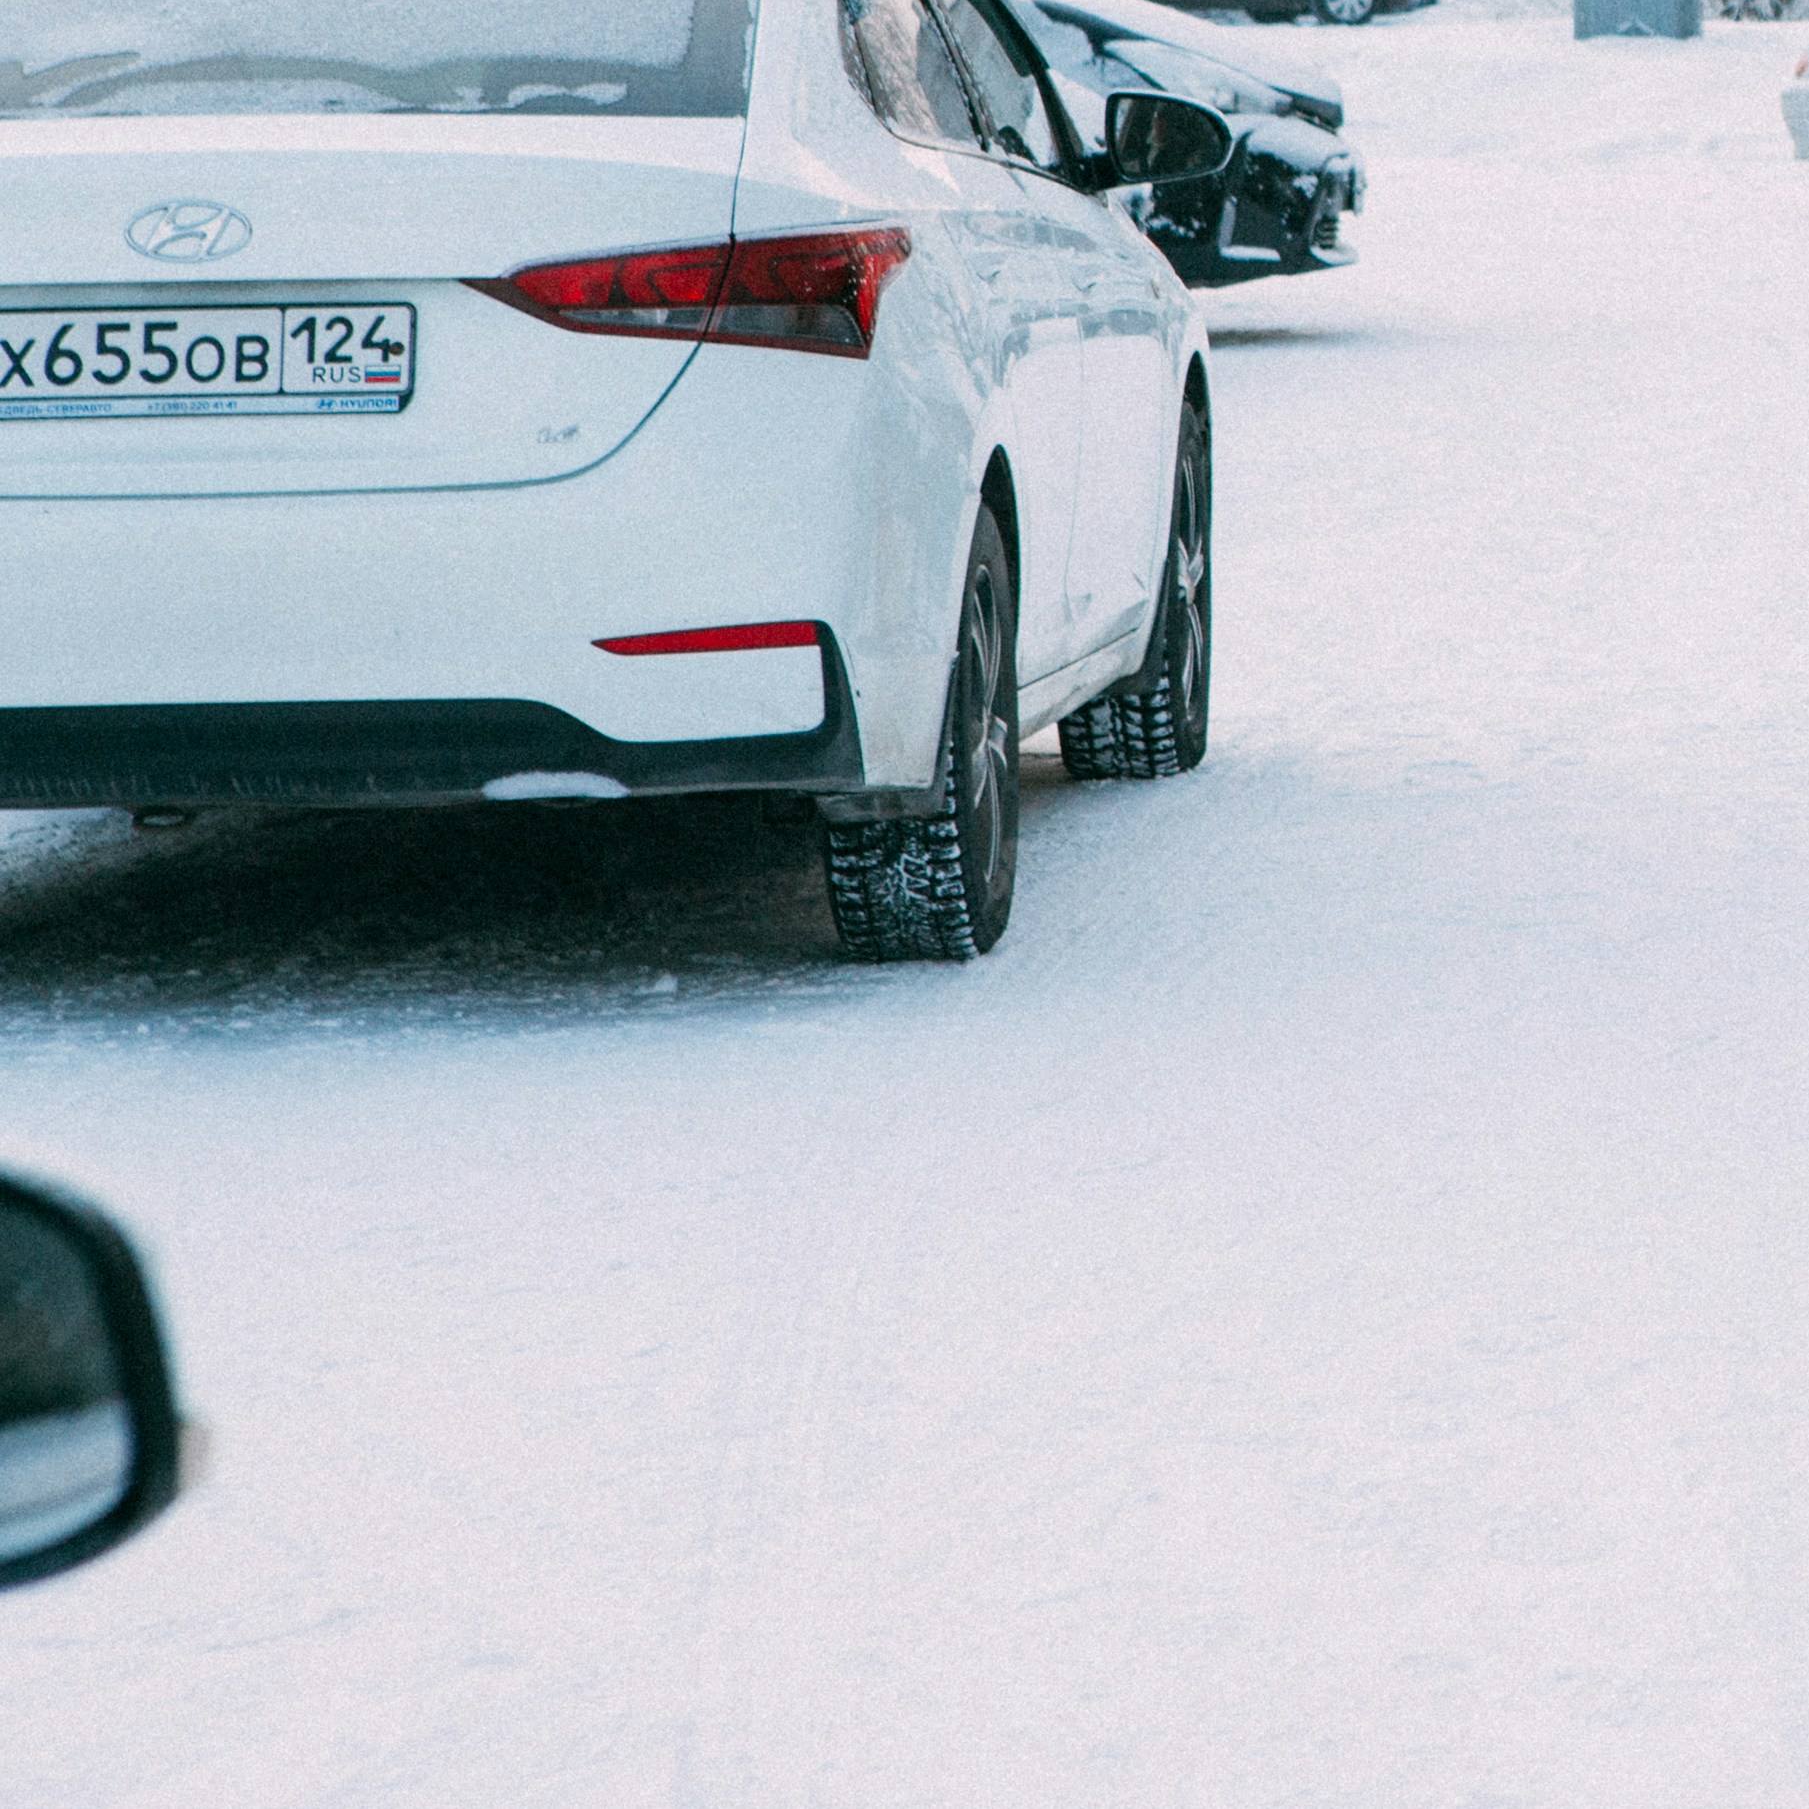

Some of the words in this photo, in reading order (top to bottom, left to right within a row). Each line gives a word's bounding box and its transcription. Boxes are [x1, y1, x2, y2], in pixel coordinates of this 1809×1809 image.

[0, 321, 270, 387] Х655ОВ
[290, 315, 396, 364] 124
[312, 365, 361, 384] RUS
[340, 398, 397, 409] HYUNDAI
